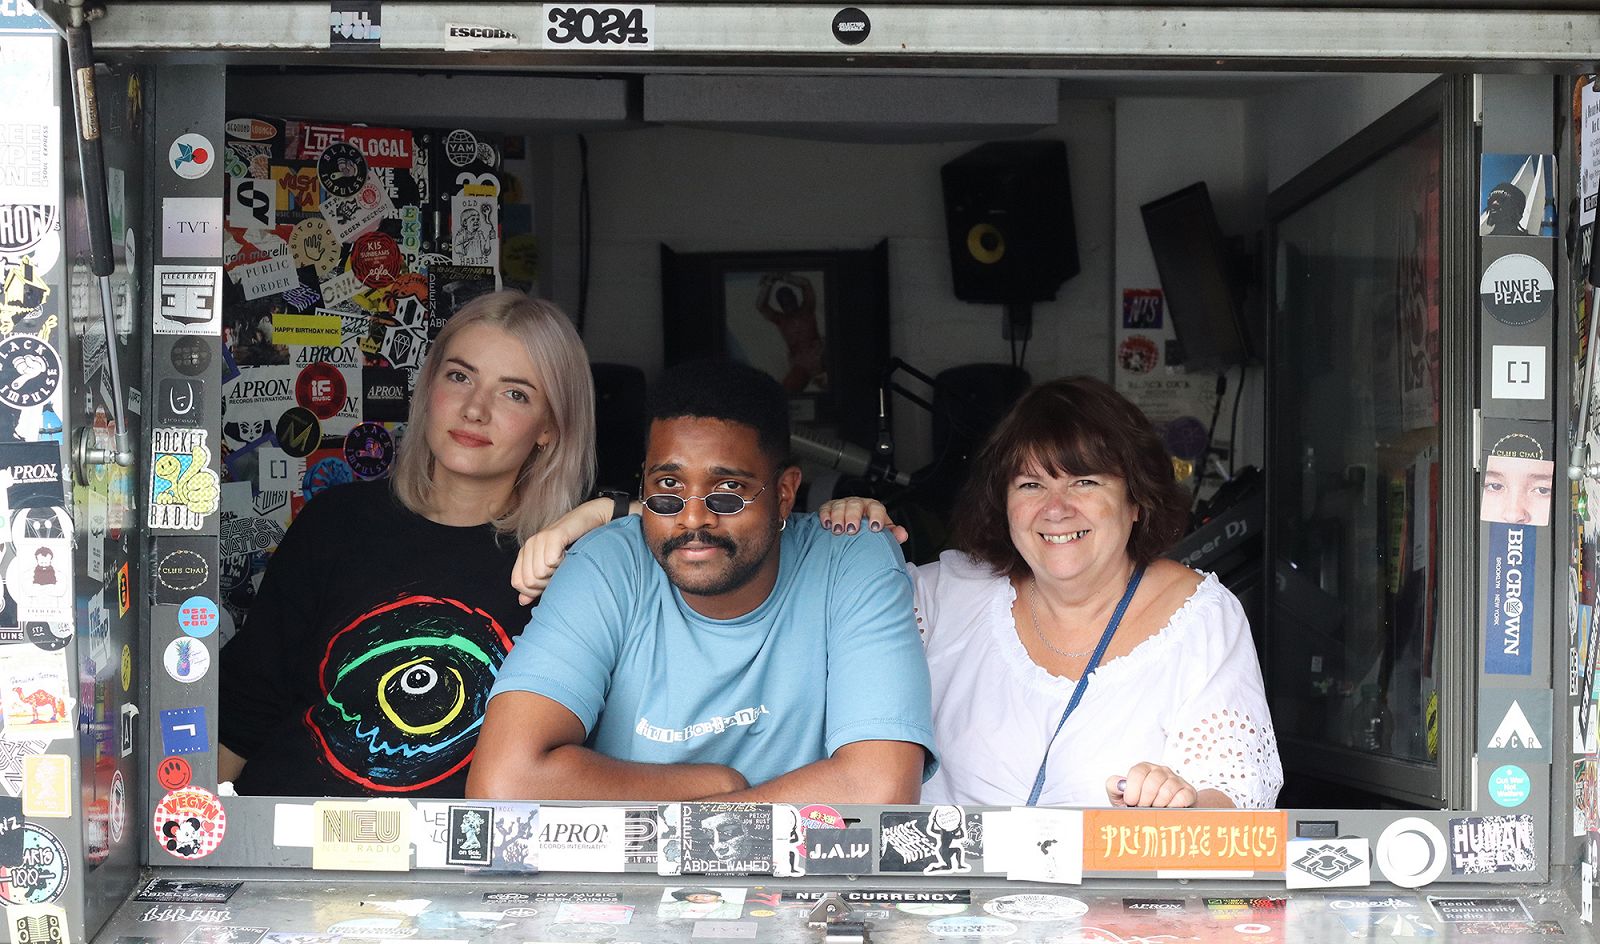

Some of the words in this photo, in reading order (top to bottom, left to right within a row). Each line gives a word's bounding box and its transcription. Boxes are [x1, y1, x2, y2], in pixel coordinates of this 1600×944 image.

[547, 8, 648, 44] 3024
[450, 144, 474, 152] YAM
[177, 221, 210, 234] TVT
[460, 256, 489, 265] HABITS
[245, 260, 290, 278] PUBLIC
[252, 278, 290, 295] ORDER
[1494, 278, 1540, 292] INNER
[1494, 290, 1542, 305] PEACE
[229, 379, 292, 399] APRON
[367, 385, 404, 397] APRON
[254, 395, 293, 403] INTERNATIONAL
[1225, 520, 1248, 539] DJ
[1507, 528, 1523, 567] BIG
[185, 567, 204, 575] CHAI
[163, 797, 219, 820] VEGYN
[323, 810, 401, 843] NEU
[682, 806, 692, 860] DEENA
[1101, 824, 1211, 857] PRIMITIVE
[1217, 824, 1277, 857] SKILLS
[1454, 821, 1532, 852] HUMAN
[357, 844, 401, 853] RADIO
[809, 843, 870, 859] J.A.W
[683, 861, 770, 872] ABDELWAHED
[849, 892, 957, 901] CURRENCY
[1128, 902, 1182, 910] APRON
[1442, 906, 1516, 914] Community
